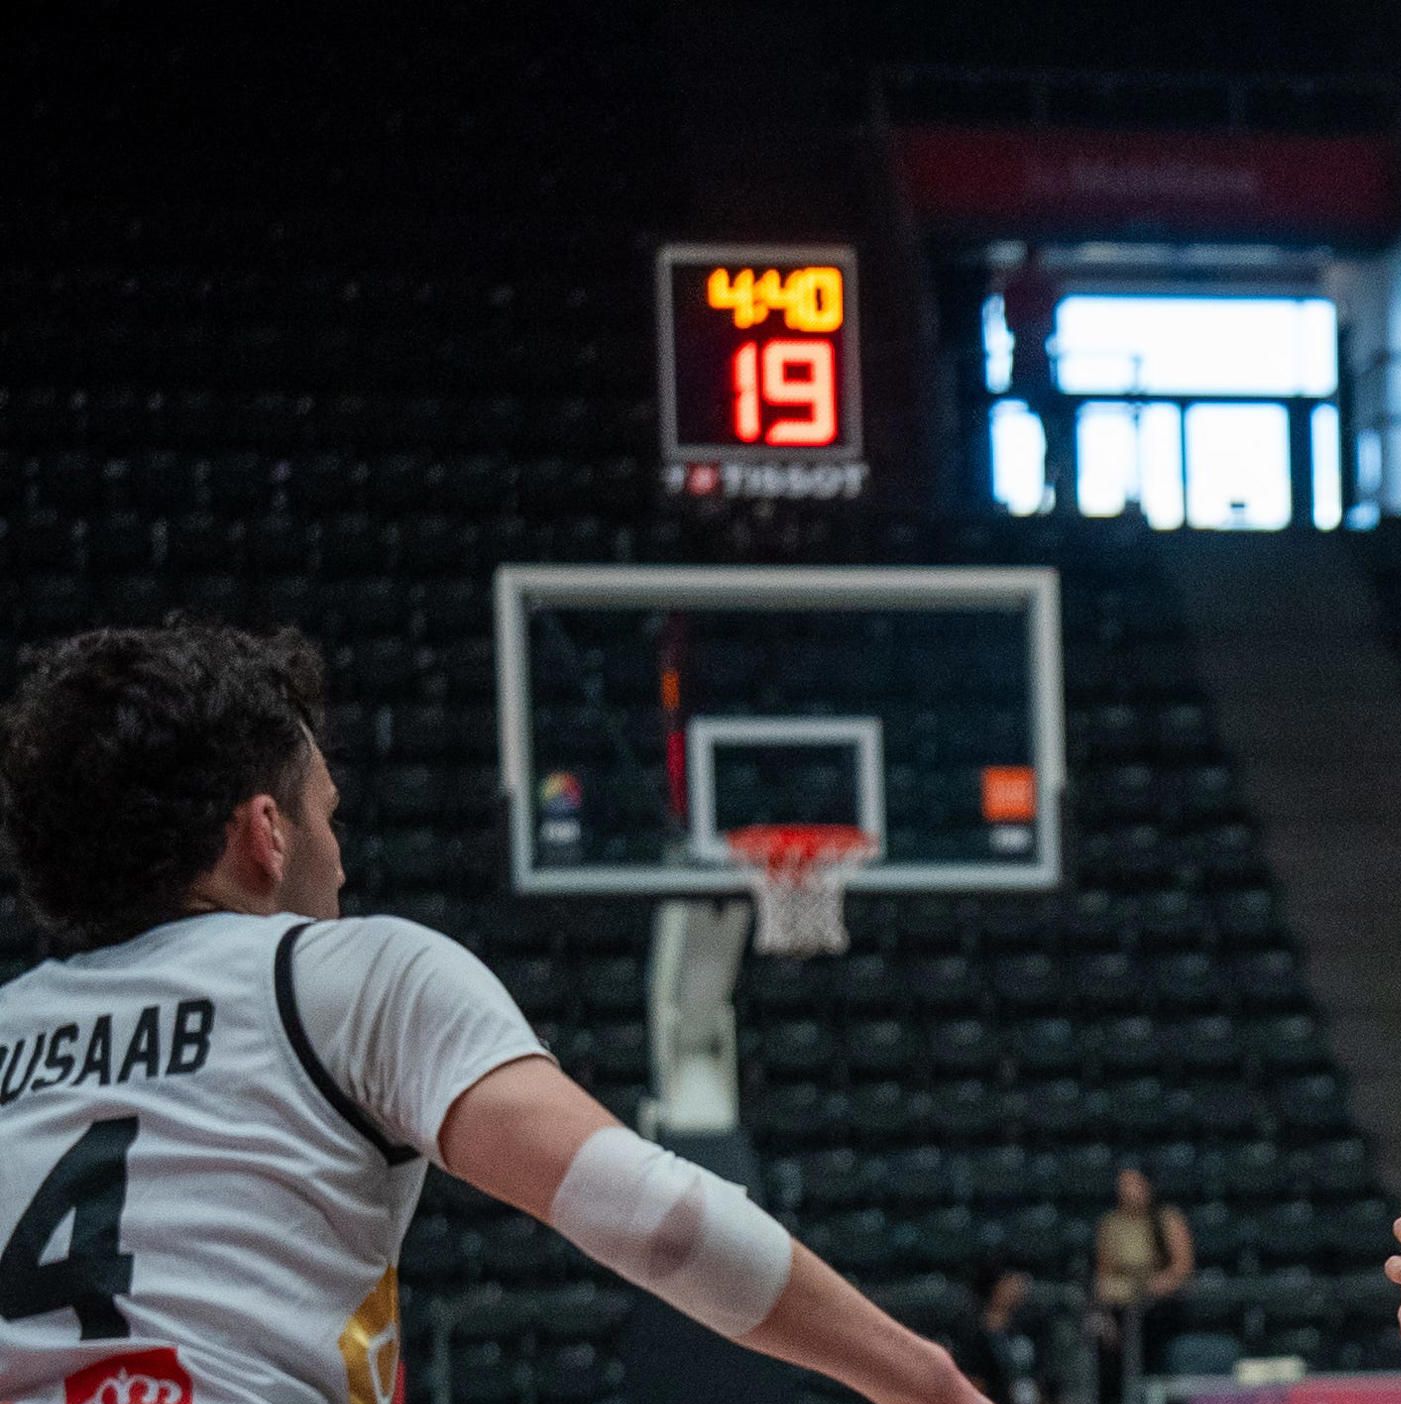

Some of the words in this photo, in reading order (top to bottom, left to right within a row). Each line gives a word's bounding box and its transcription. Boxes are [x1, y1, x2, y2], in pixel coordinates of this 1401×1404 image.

[732, 339, 837, 446] 19
[0, 998, 215, 1105] USAAB
[0, 1116, 139, 1341] 4
